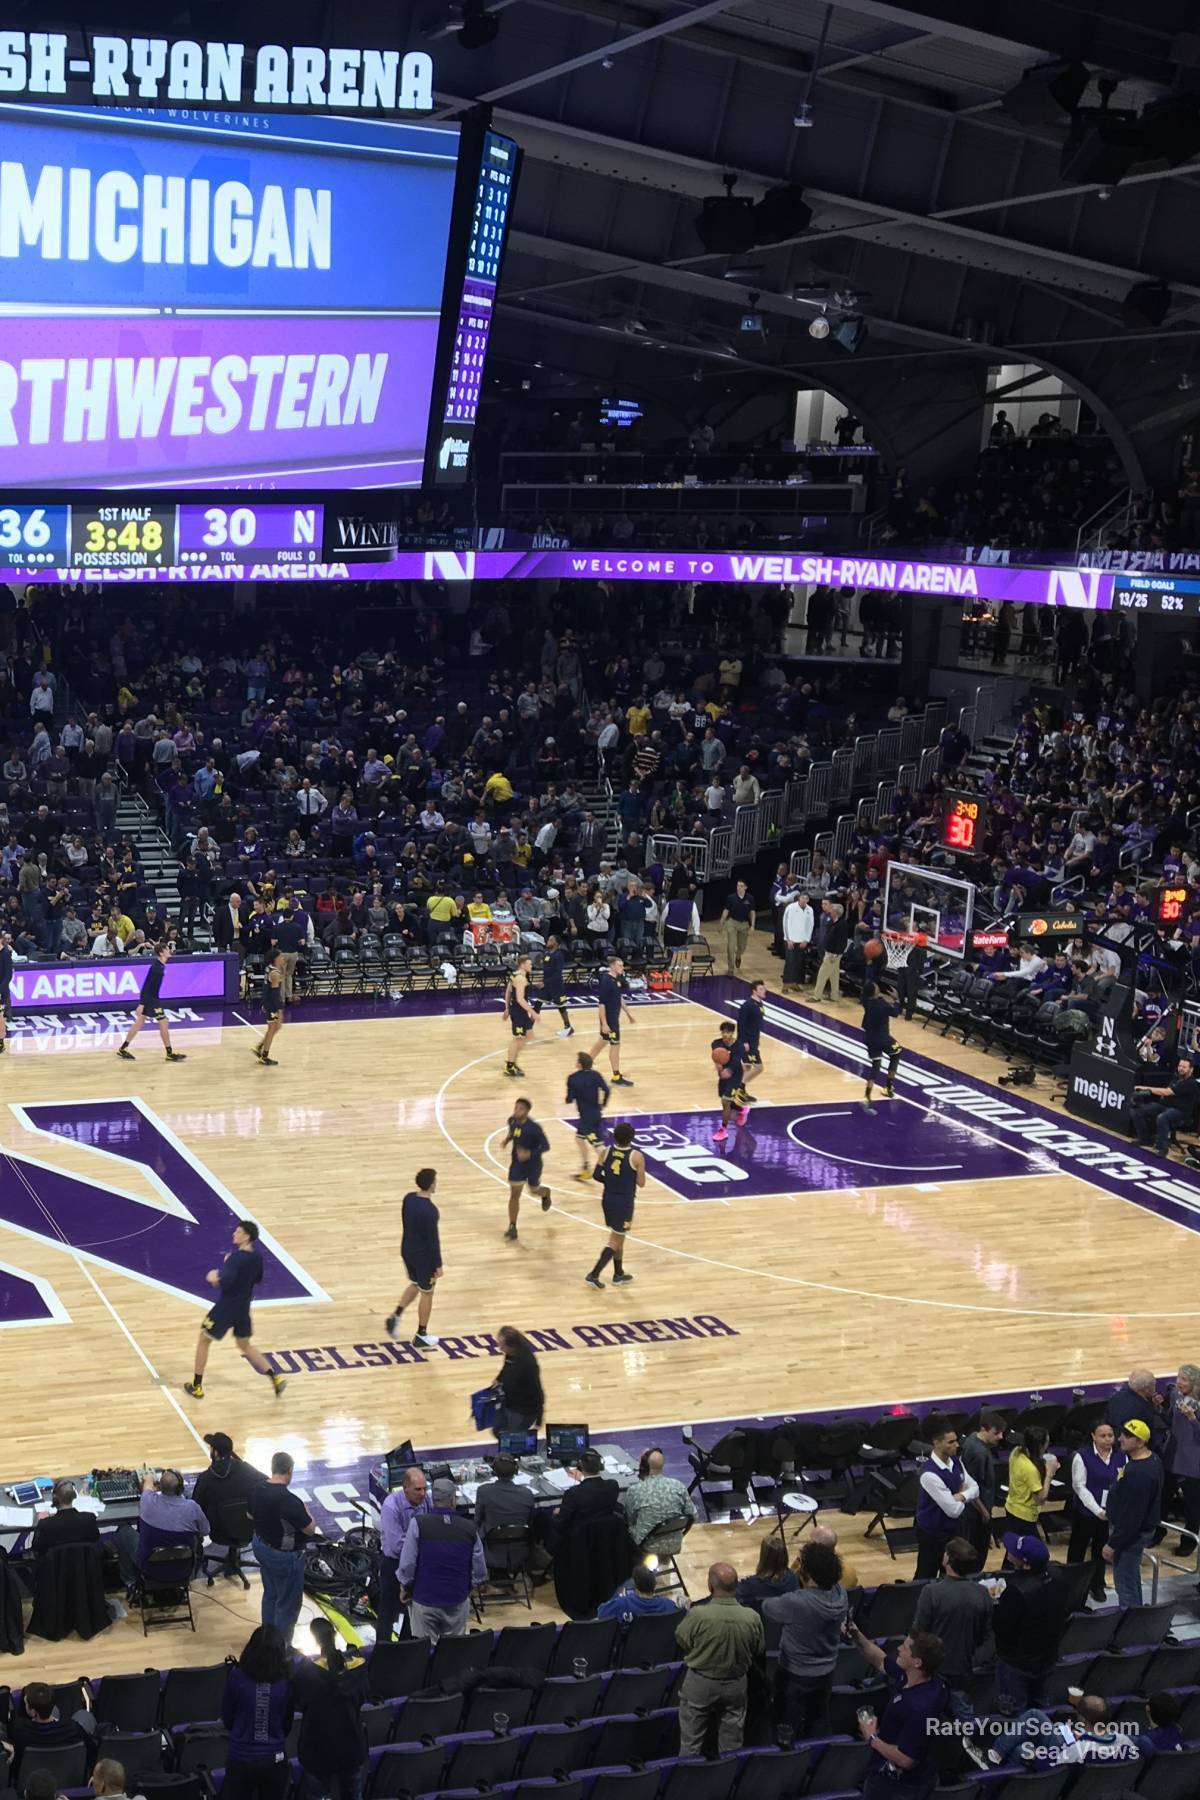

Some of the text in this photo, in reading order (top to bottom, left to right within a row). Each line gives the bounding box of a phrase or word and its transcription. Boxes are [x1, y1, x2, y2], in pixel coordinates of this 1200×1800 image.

[254, 45, 433, 110] ARENA
[168, 108, 270, 129] WOLVERINES
[98, 508, 152, 521] 1ST HALF
[85, 521, 163, 551] 3:48
[202, 508, 257, 546] 30
[293, 510, 315, 544] N
[8, 553, 25, 563] TOL
[74, 552, 148, 565] POSSESSION
[220, 552, 236, 562] TOL
[277, 551, 316, 562] FOULS 0
[423, 552, 474, 580] N
[571, 556, 978, 595] WELCOME TO WELSH-RYAN ARENA
[1130, 578, 1175, 591] FIELD GOALS
[1047, 570, 1102, 609] N
[1118, 592, 1148, 609] 13/25
[1161, 594, 1184, 611] 52%
[955, 800, 978, 819] 3:48
[949, 815, 974, 846] 30
[1162, 902, 1179, 918] 30
[30, 970, 140, 1000] ARENA
[1102, 1016, 1114, 1038] N
[1074, 1076, 1125, 1110] meijer
[923, 1084, 1171, 1181] WILDCATS
[611, 1159, 622, 1175] 4
[241, 1314, 740, 1377] WELSH-RYN ARENA
